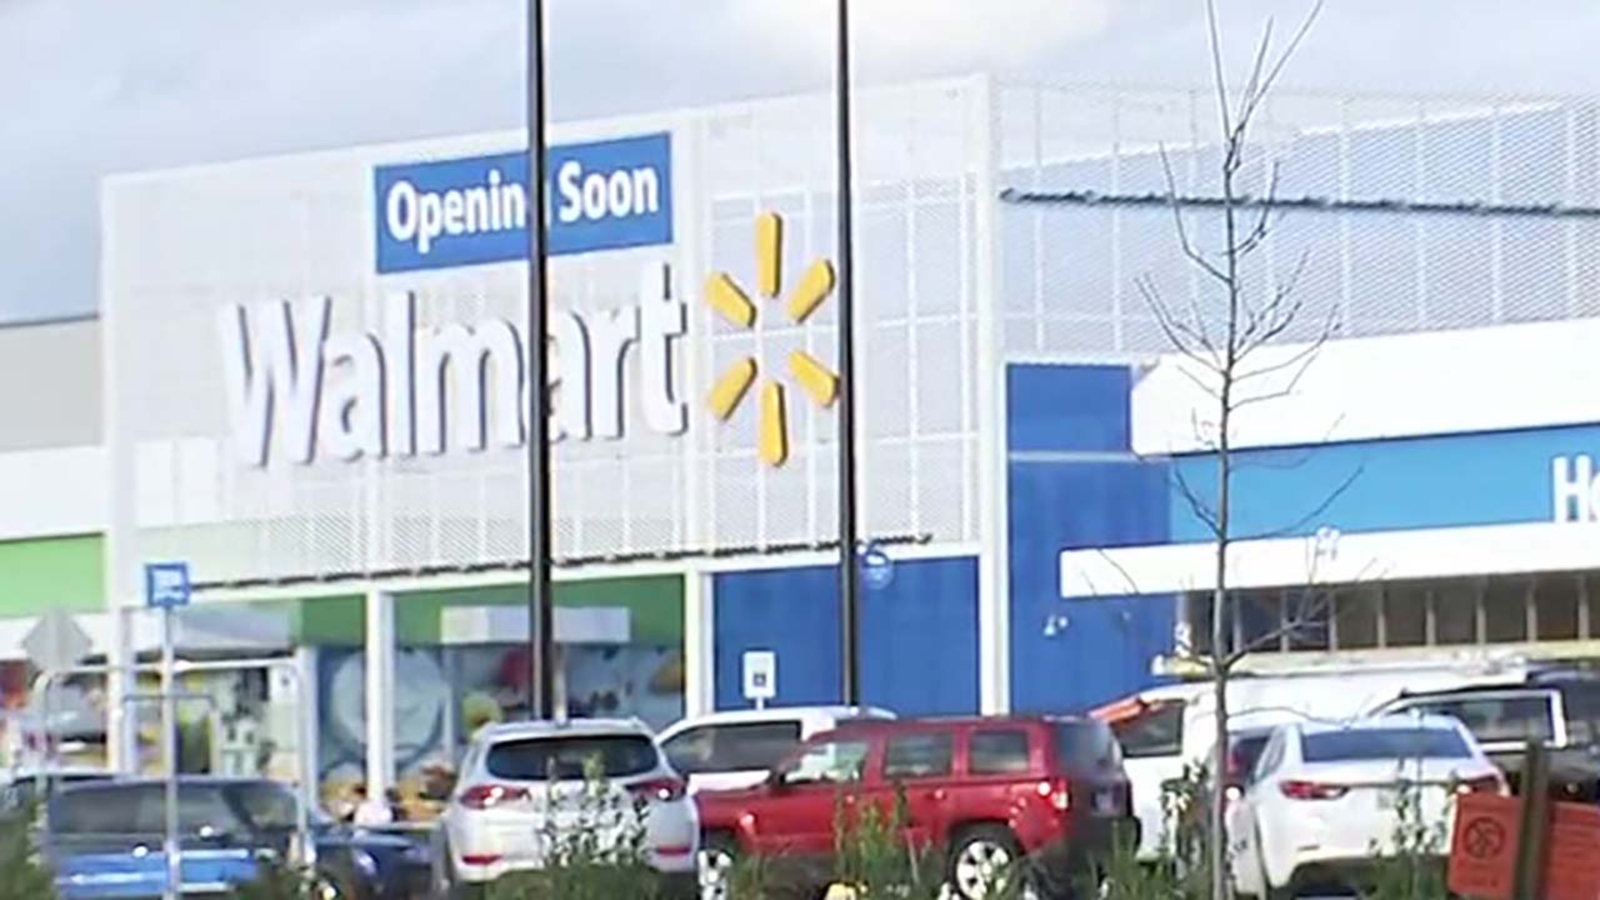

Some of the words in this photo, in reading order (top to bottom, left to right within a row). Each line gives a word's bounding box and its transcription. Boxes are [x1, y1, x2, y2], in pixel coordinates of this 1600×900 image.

[387, 170, 551, 254] Openin
[558, 160, 659, 223] Soon
[220, 259, 689, 469] Walmart
